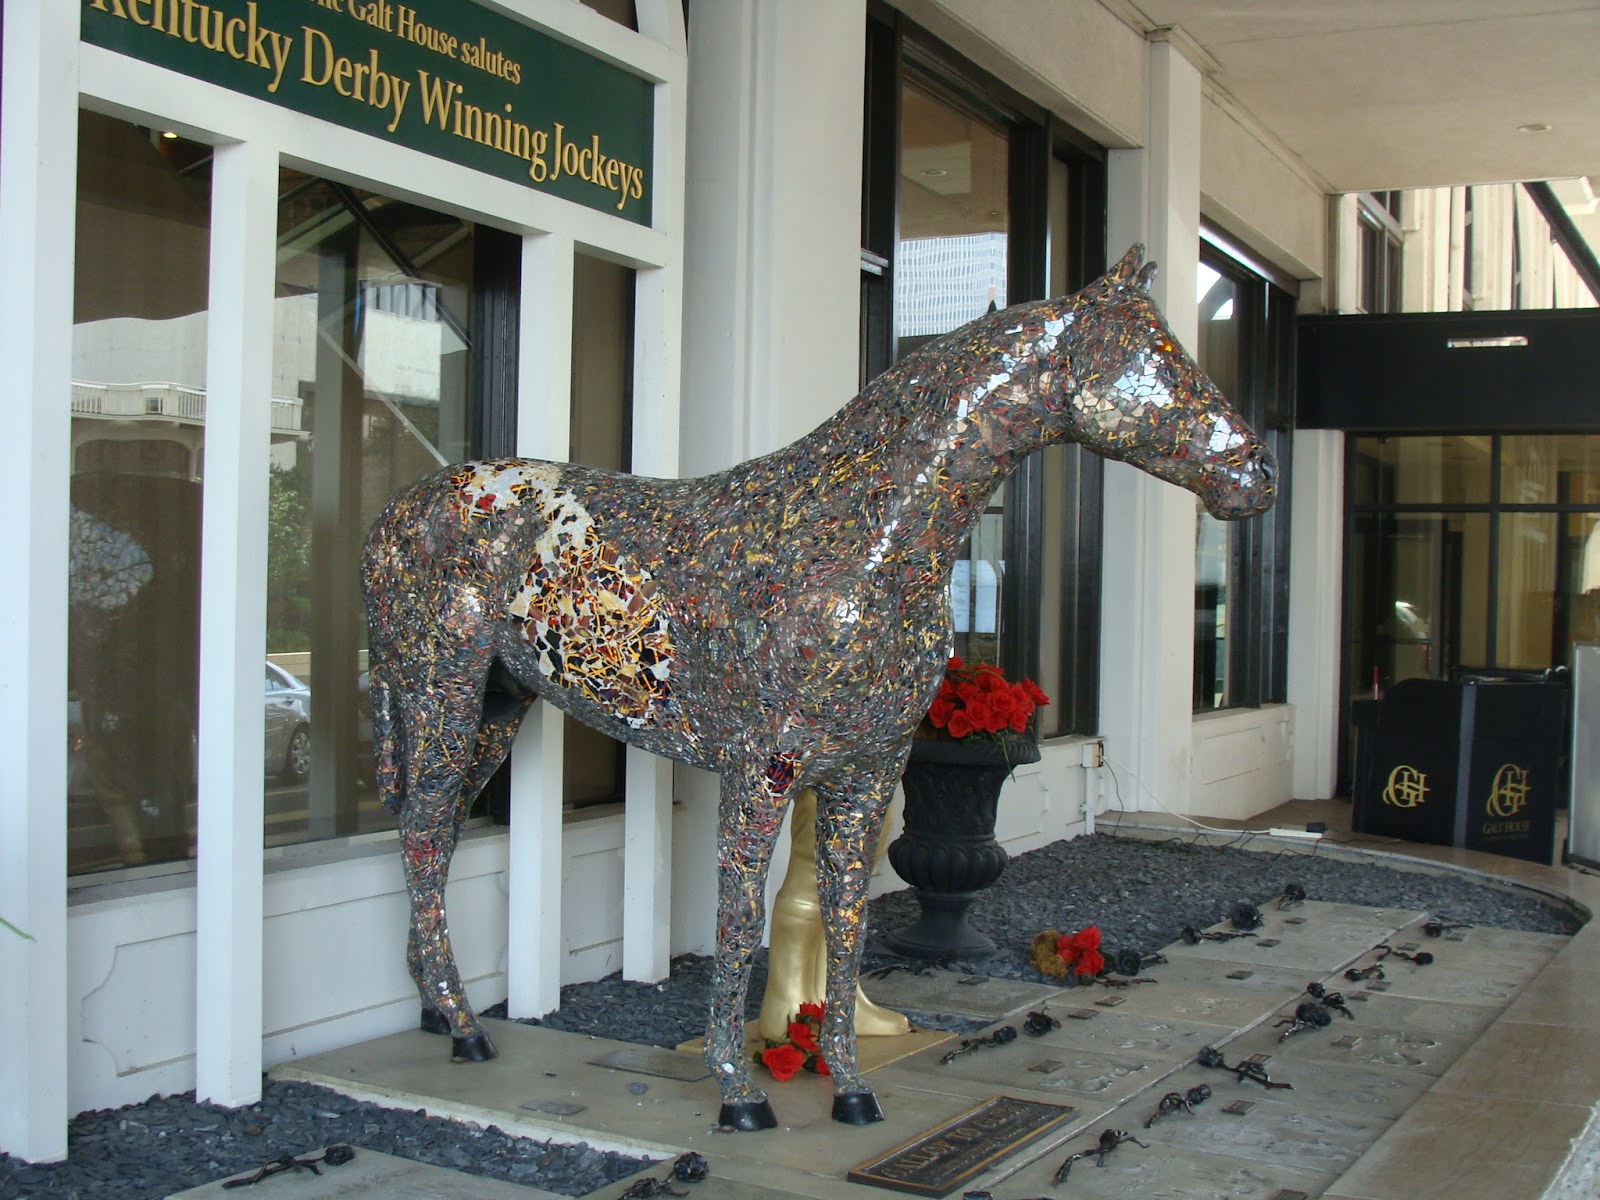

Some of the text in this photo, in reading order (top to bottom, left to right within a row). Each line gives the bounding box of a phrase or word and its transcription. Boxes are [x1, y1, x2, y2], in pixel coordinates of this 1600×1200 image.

[89, 0, 644, 211] entucky Derby Winning Jockeys
[346, 0, 521, 85] Galt House salutes
